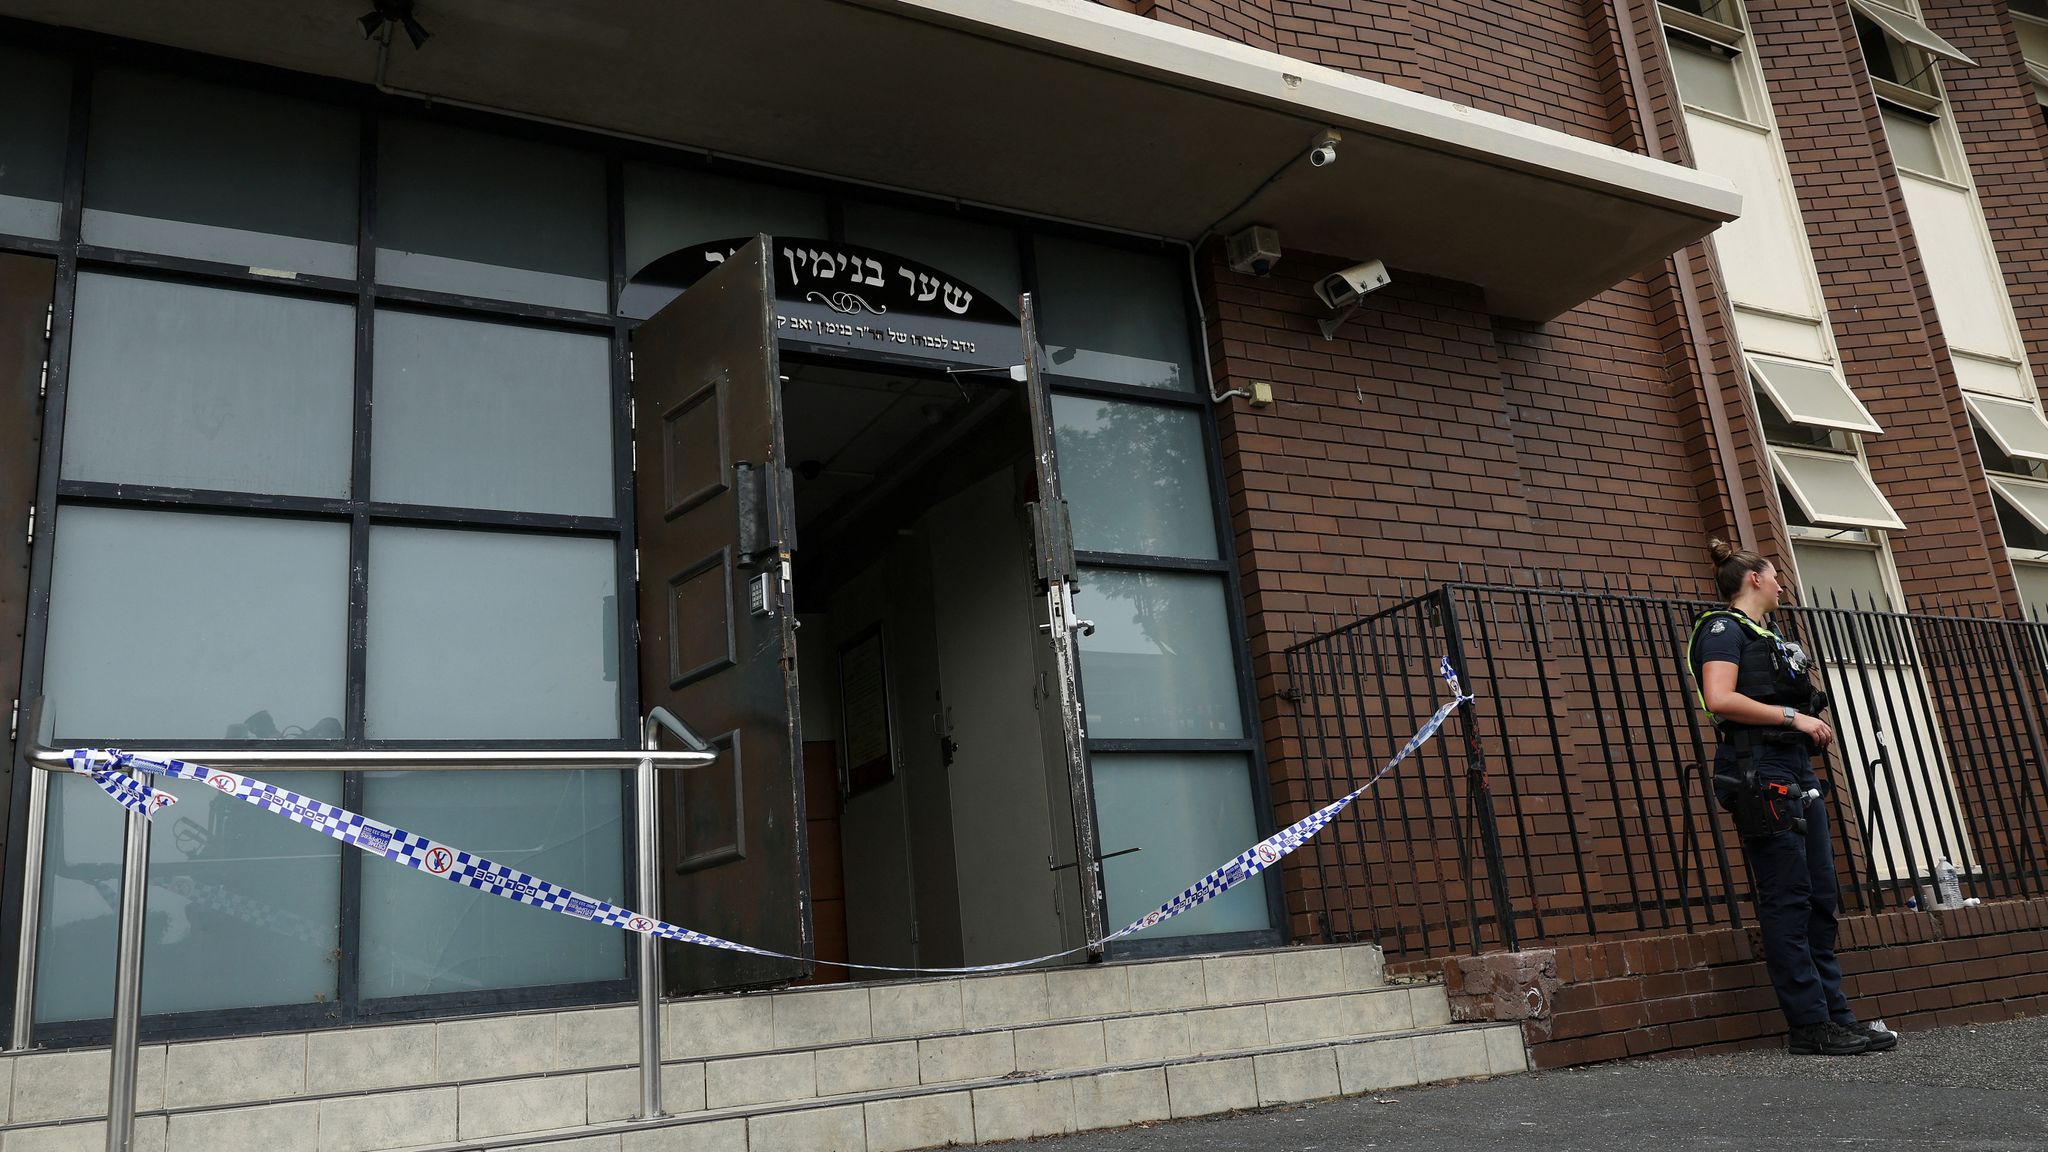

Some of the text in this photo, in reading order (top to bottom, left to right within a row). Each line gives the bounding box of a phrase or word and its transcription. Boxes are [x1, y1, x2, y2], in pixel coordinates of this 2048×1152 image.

[783, 247, 973, 314] שער בנימין
[790, 317, 813, 331] זאב
[887, 327, 907, 343] של
[262, 791, 326, 824] POLICE
[475, 869, 537, 896] POLICE
[1173, 886, 1209, 911] POLICE
